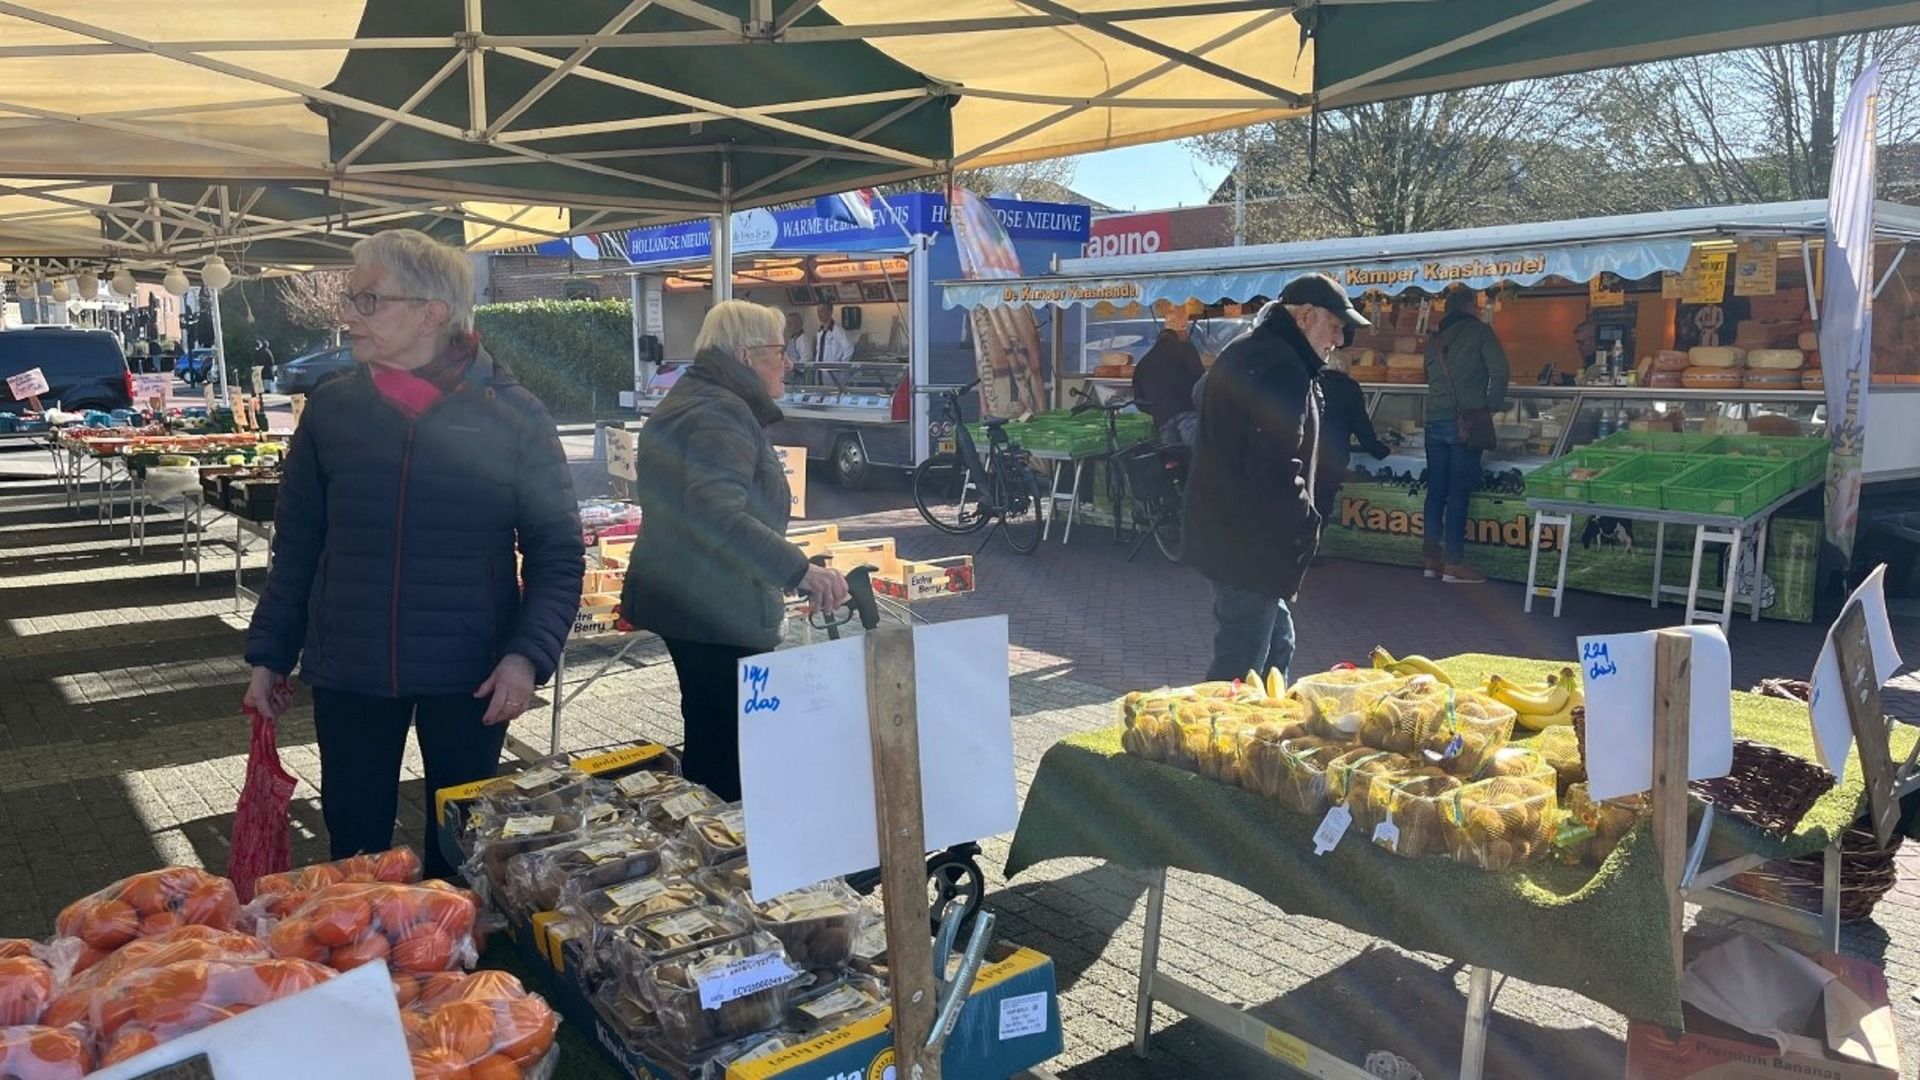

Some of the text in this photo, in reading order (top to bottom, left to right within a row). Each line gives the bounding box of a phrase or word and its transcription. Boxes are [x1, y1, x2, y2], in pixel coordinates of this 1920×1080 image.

[782, 218, 822, 238] WARME
[1026, 213, 1083, 234] NIEUWE
[631, 233, 681, 255] HOLLANDSE
[681, 228, 712, 247] NIEUW
[1346, 268, 1418, 288] Kamper
[1423, 256, 1547, 280] Kaashandel
[573, 622, 605, 633] Berry
[1694, 1041, 1768, 1067] Premium
